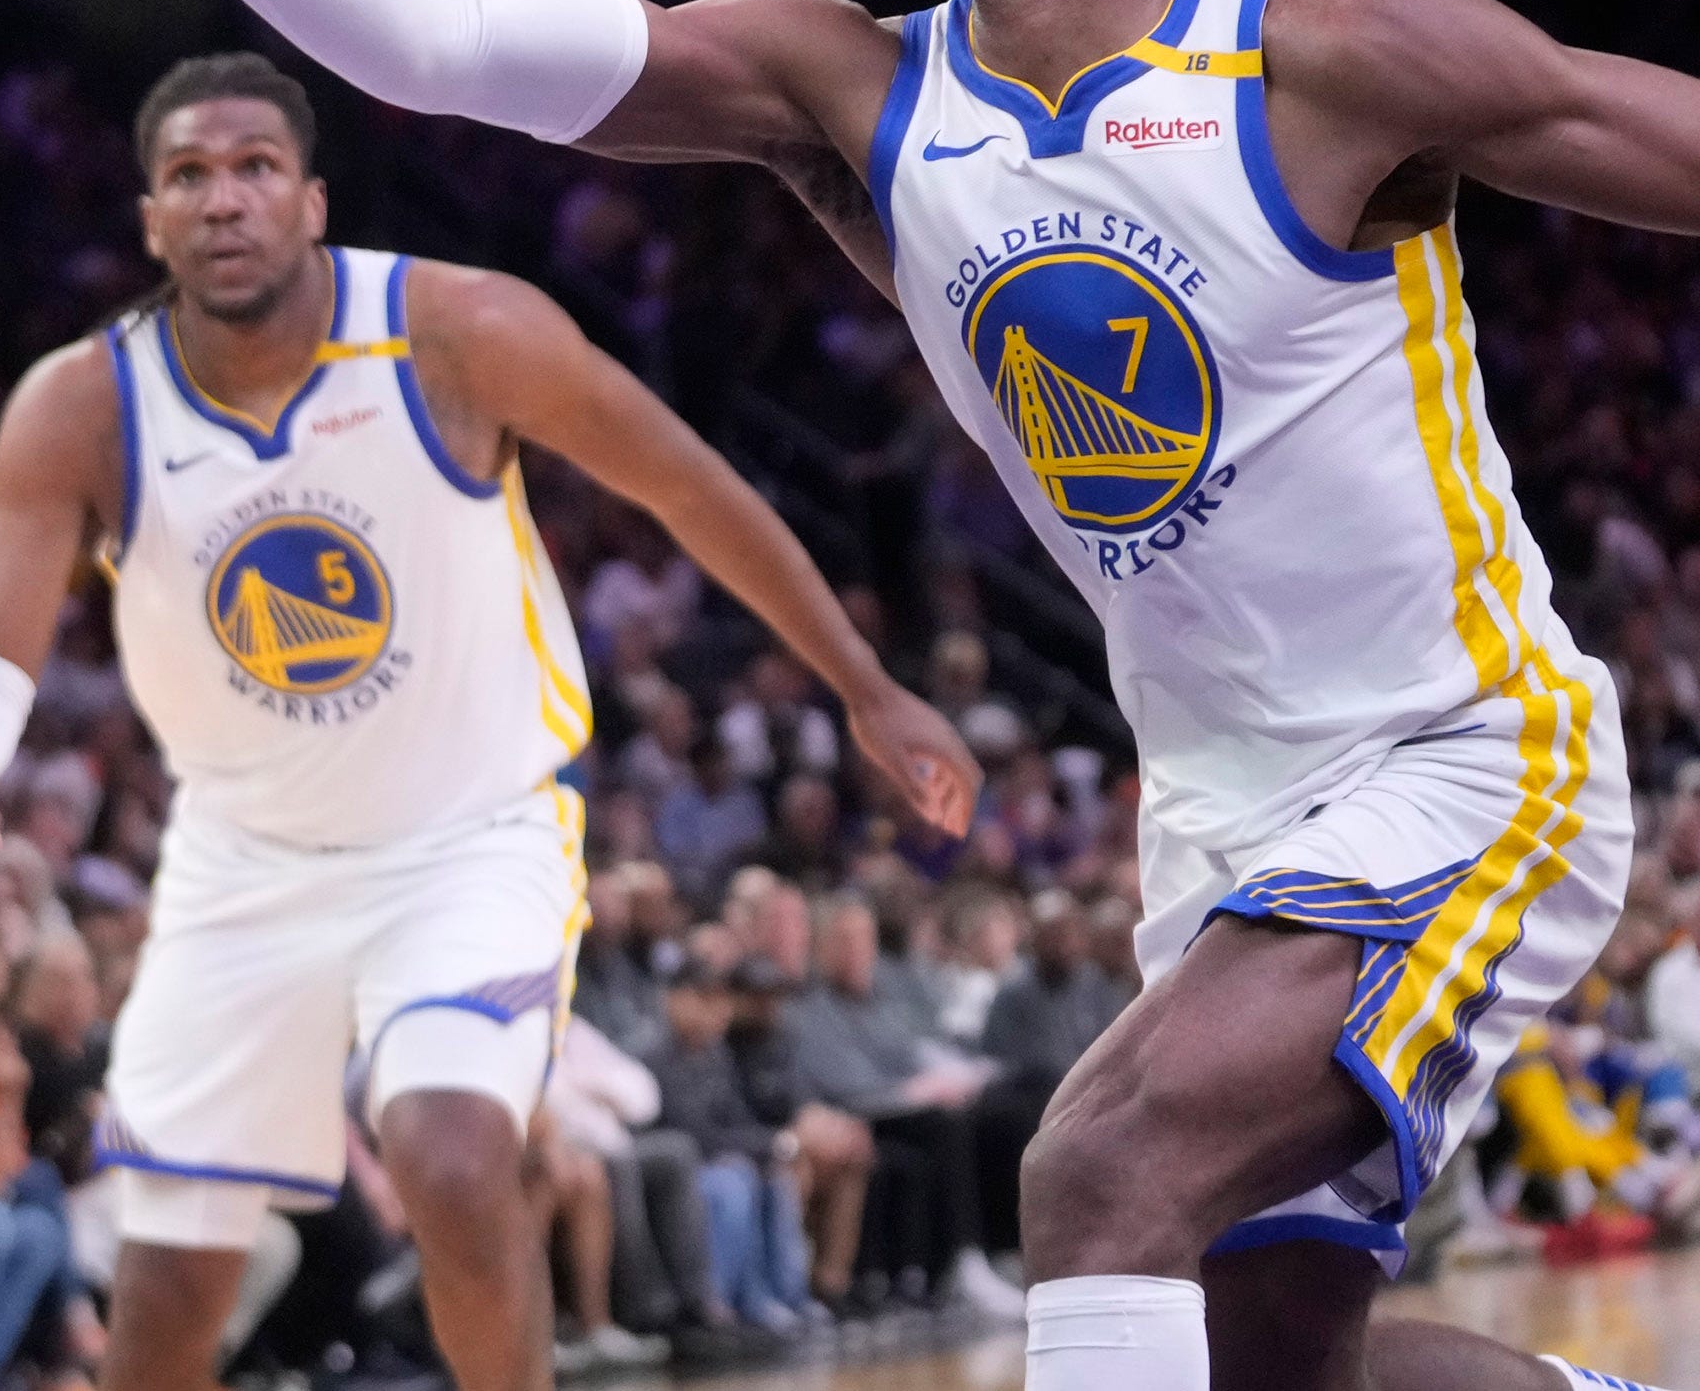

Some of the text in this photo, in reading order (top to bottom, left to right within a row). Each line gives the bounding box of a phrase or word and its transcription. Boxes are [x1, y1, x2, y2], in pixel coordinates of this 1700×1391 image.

[1185, 54, 1210, 72] 16
[1105, 117, 1220, 145] Rakuten
[945, 211, 1208, 308] GOLDEN STATE
[1107, 317, 1149, 394] 7
[317, 550, 356, 605] 5
[227, 650, 414, 725] WARRIORS
